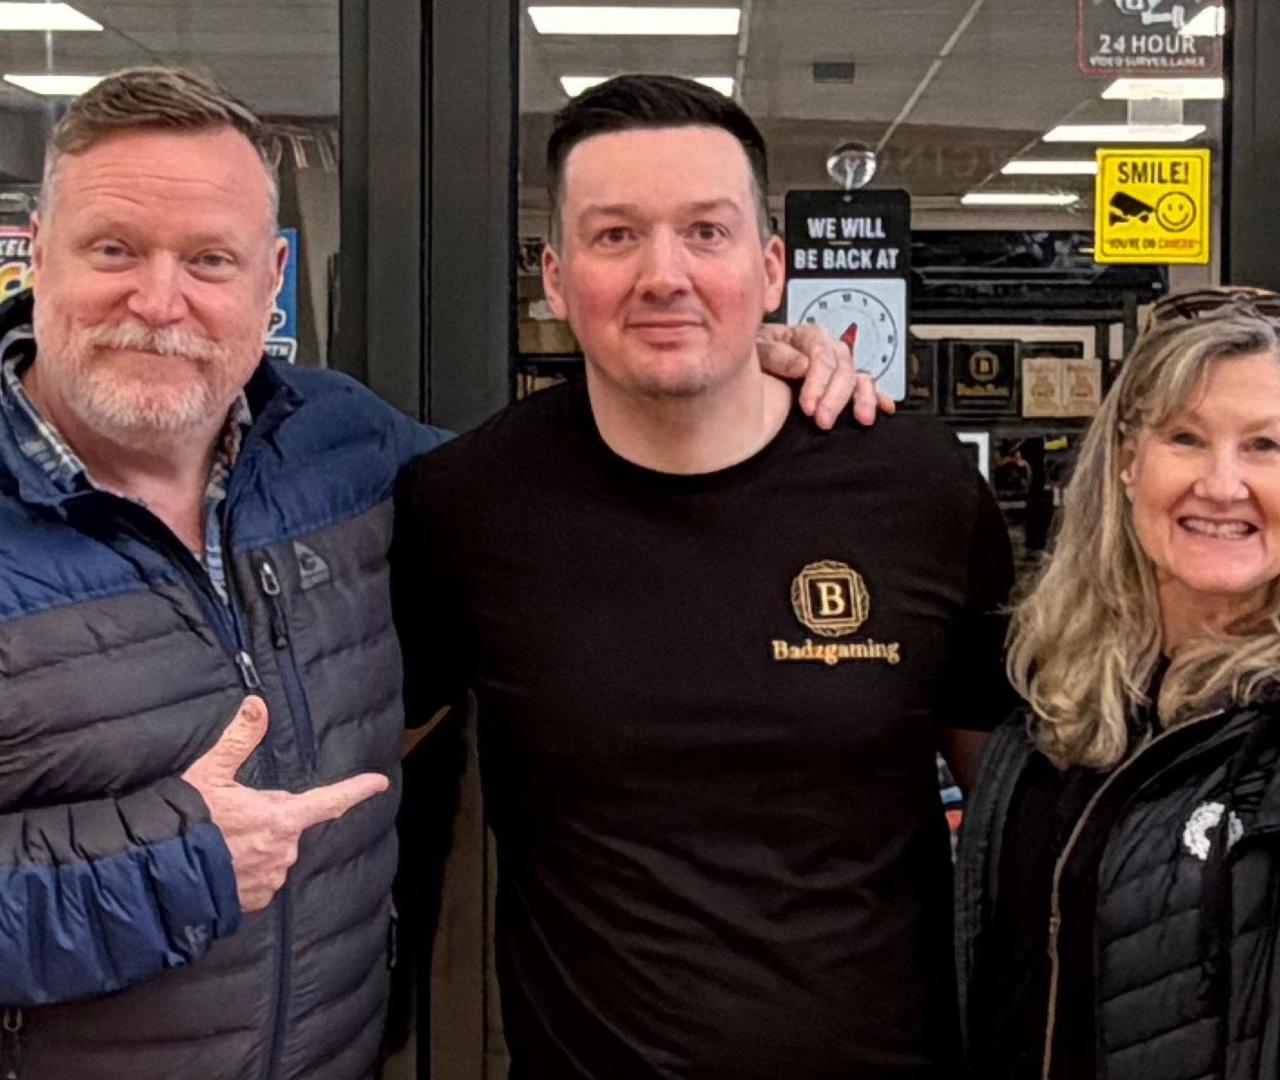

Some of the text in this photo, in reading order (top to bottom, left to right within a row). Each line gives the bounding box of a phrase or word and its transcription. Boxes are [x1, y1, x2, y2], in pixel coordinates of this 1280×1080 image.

[1099, 34, 1197, 54] 24 HOUR
[1117, 160, 1190, 185] SMILE!
[807, 217, 886, 238] WE WILL
[794, 248, 901, 270] BE BACK AT
[816, 582, 846, 616] B
[772, 638, 900, 666] Badzgaming
